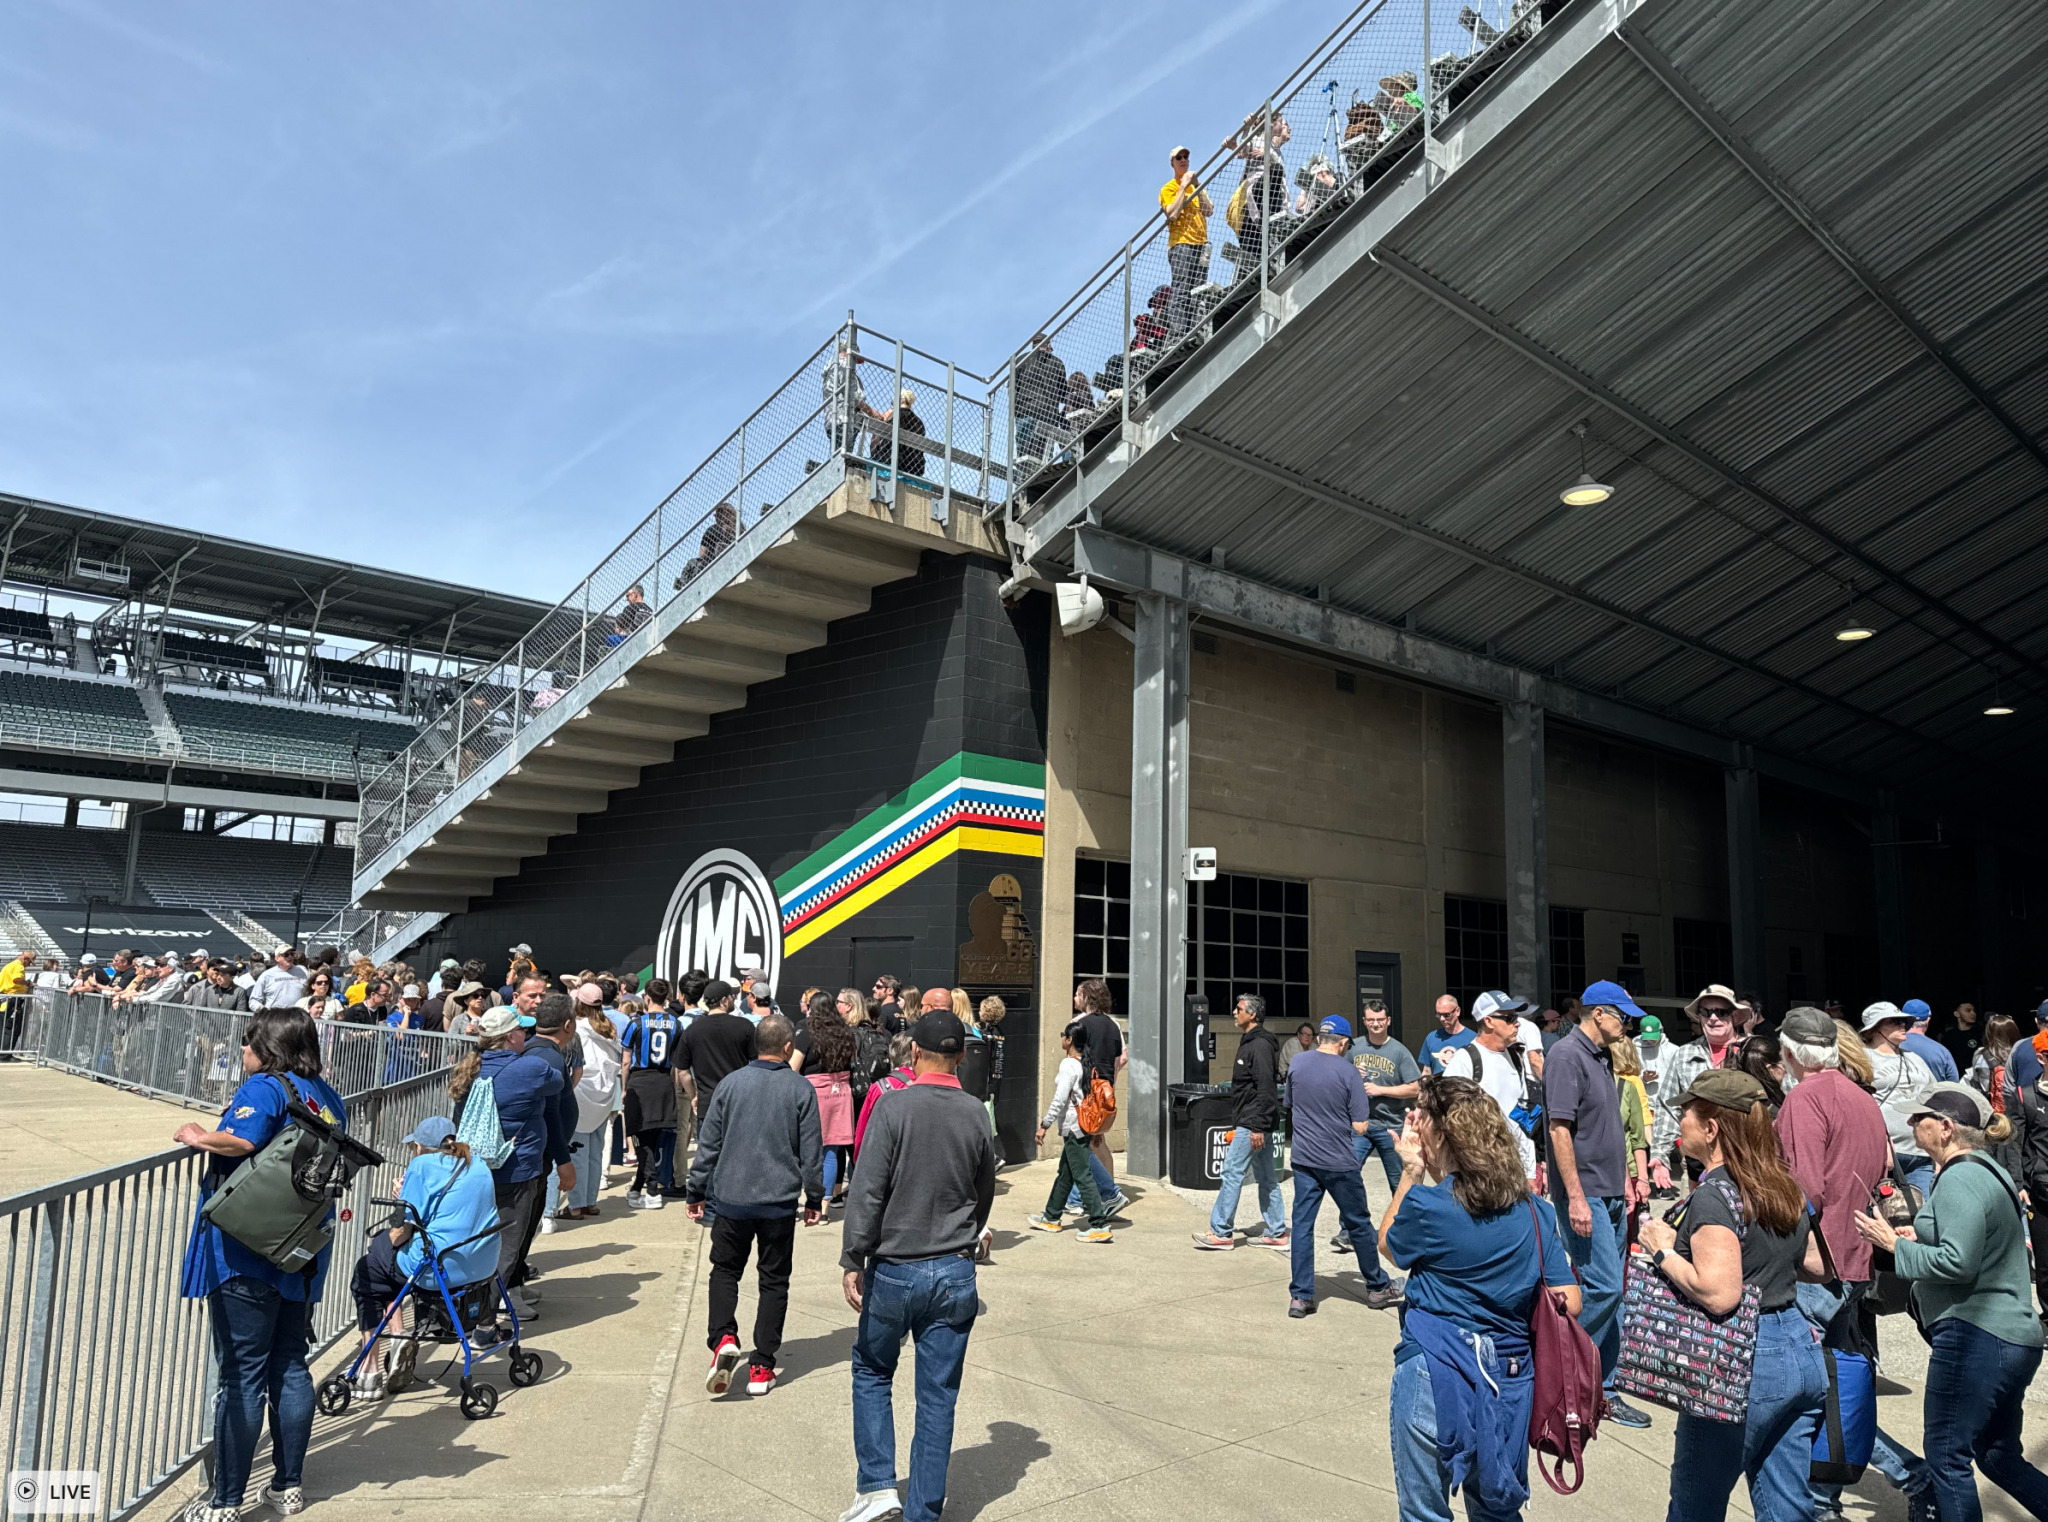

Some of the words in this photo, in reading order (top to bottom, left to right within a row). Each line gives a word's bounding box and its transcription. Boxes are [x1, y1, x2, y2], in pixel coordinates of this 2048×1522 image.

[62, 927, 208, 938] verizon
[964, 962, 1029, 975] YEARS
[650, 1031, 667, 1063] 9
[1353, 1053, 1395, 1077] PURDUE
